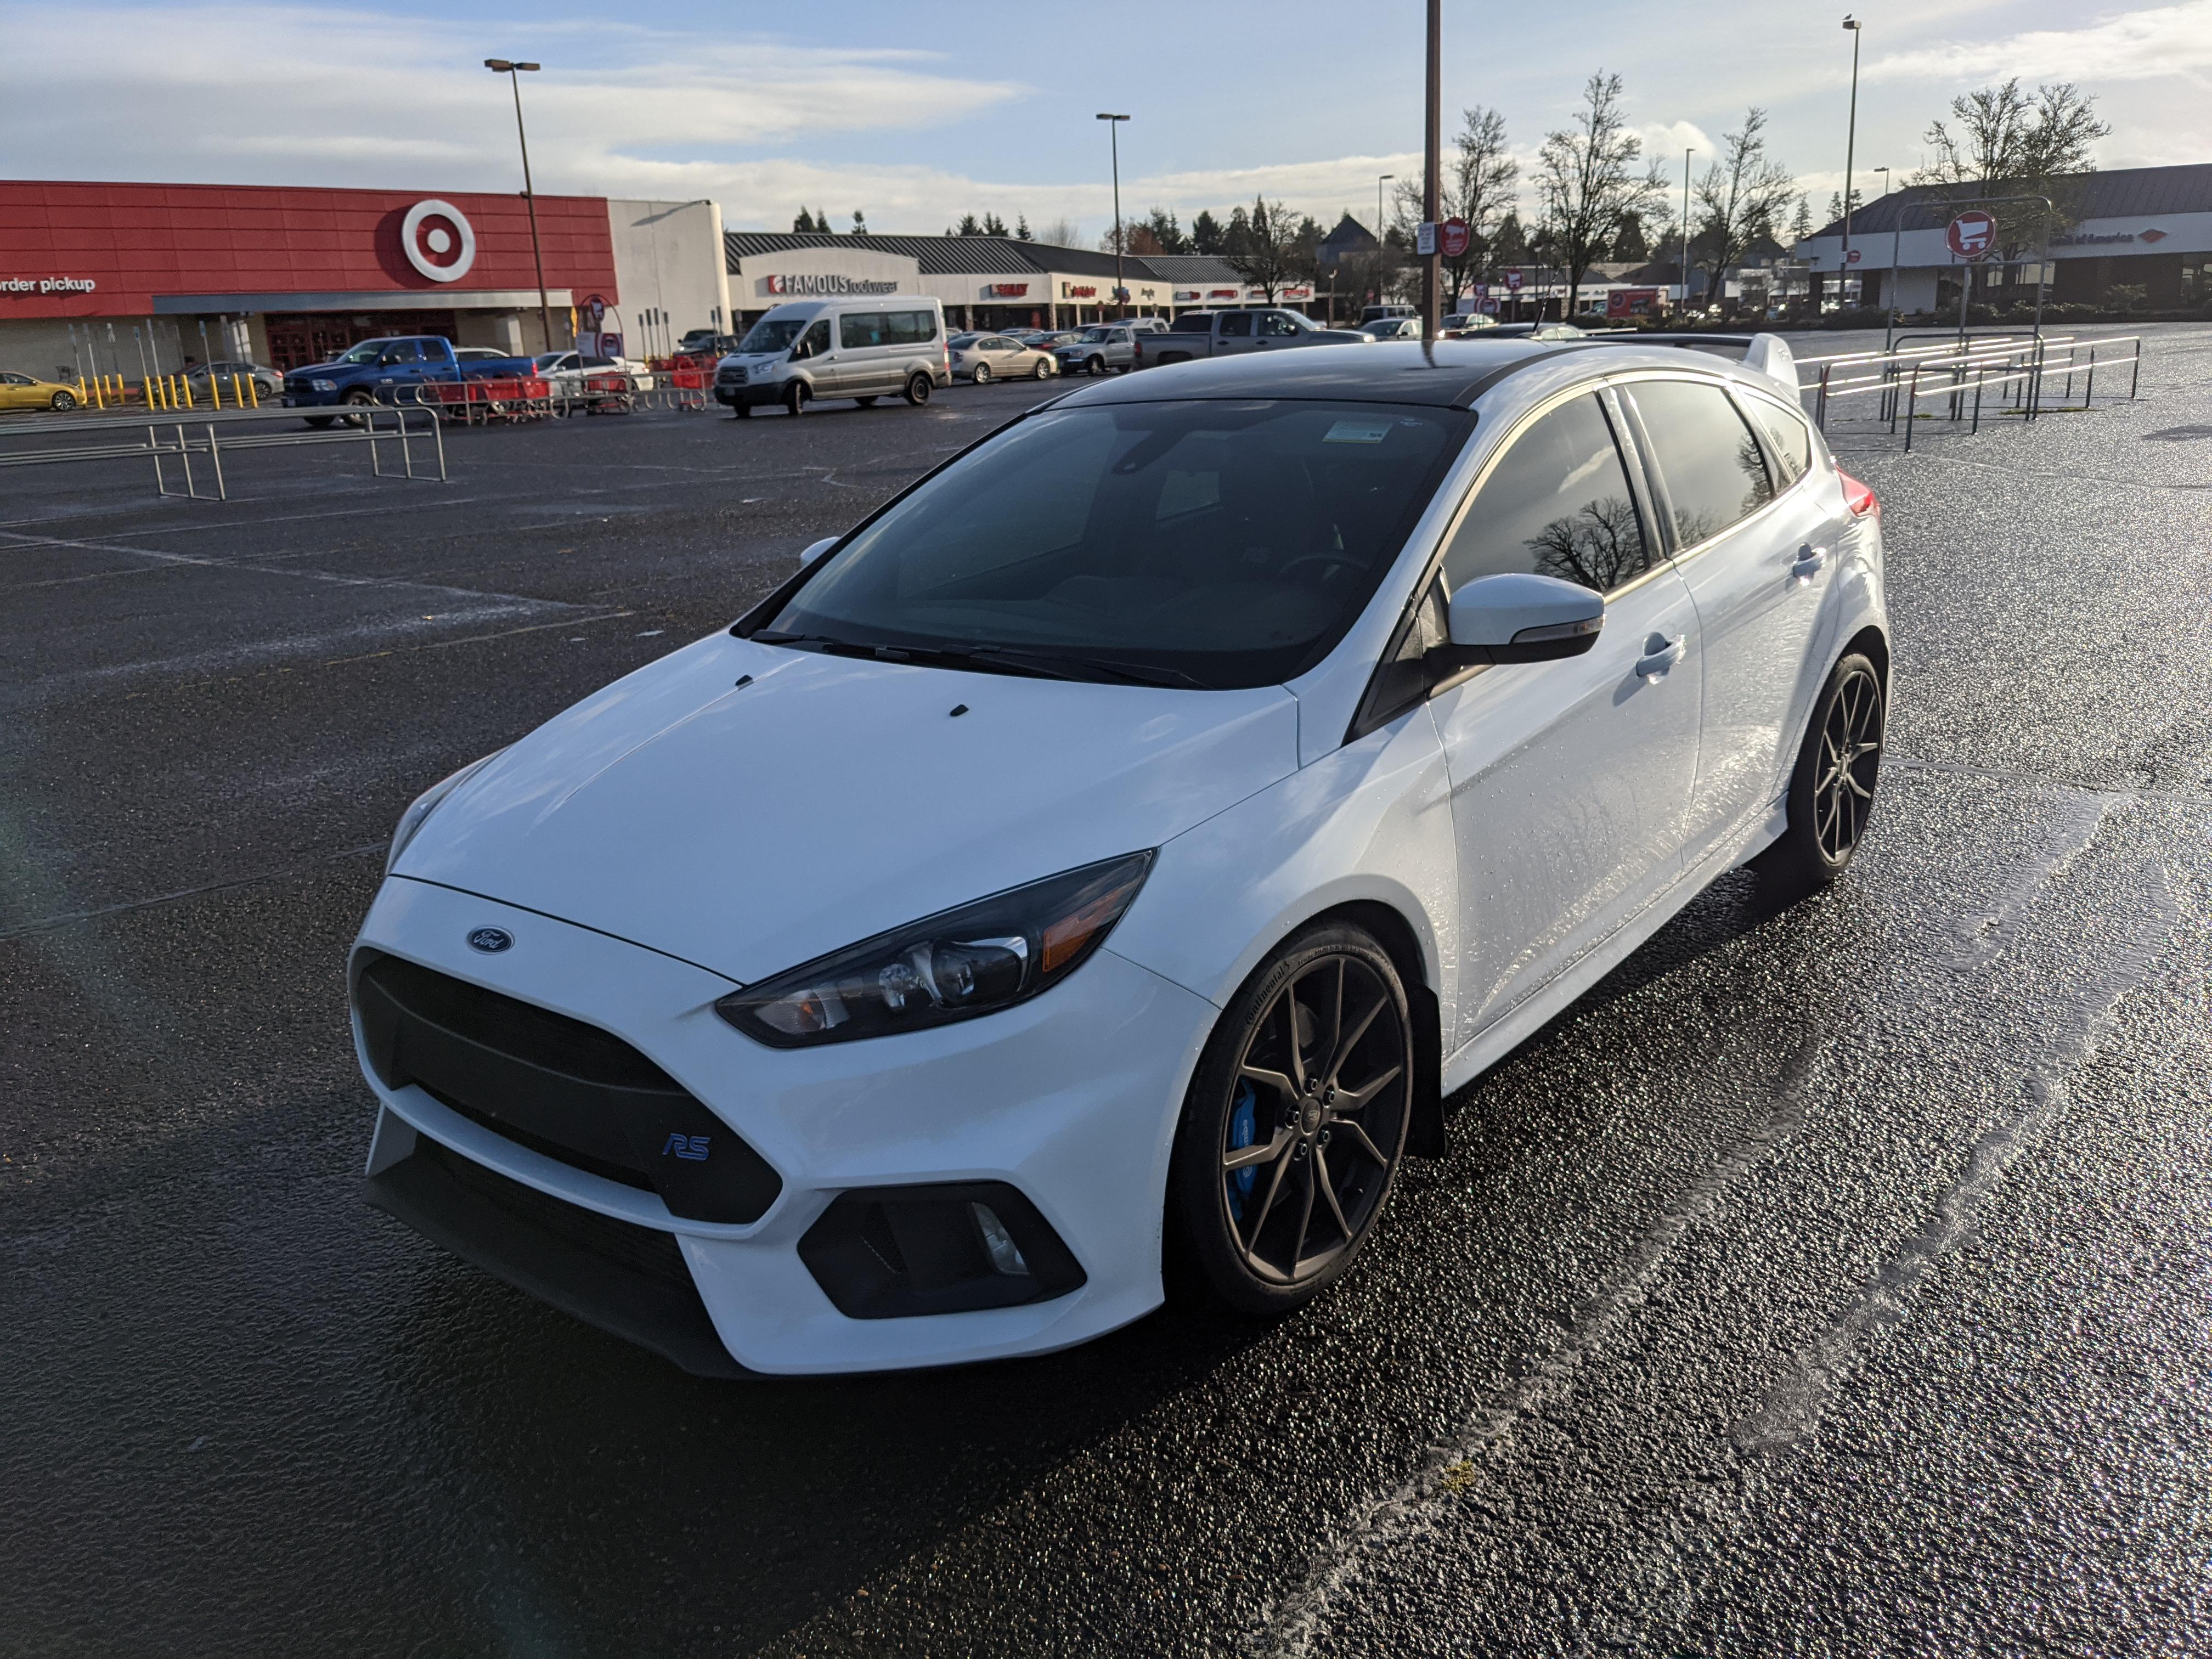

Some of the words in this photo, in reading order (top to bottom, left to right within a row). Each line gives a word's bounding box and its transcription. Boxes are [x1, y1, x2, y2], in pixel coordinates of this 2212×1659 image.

[40, 276, 95, 294] pickup
[785, 275, 848, 293] FAMOUS
[473, 930, 504, 949] Ford
[662, 1133, 711, 1160] RS
